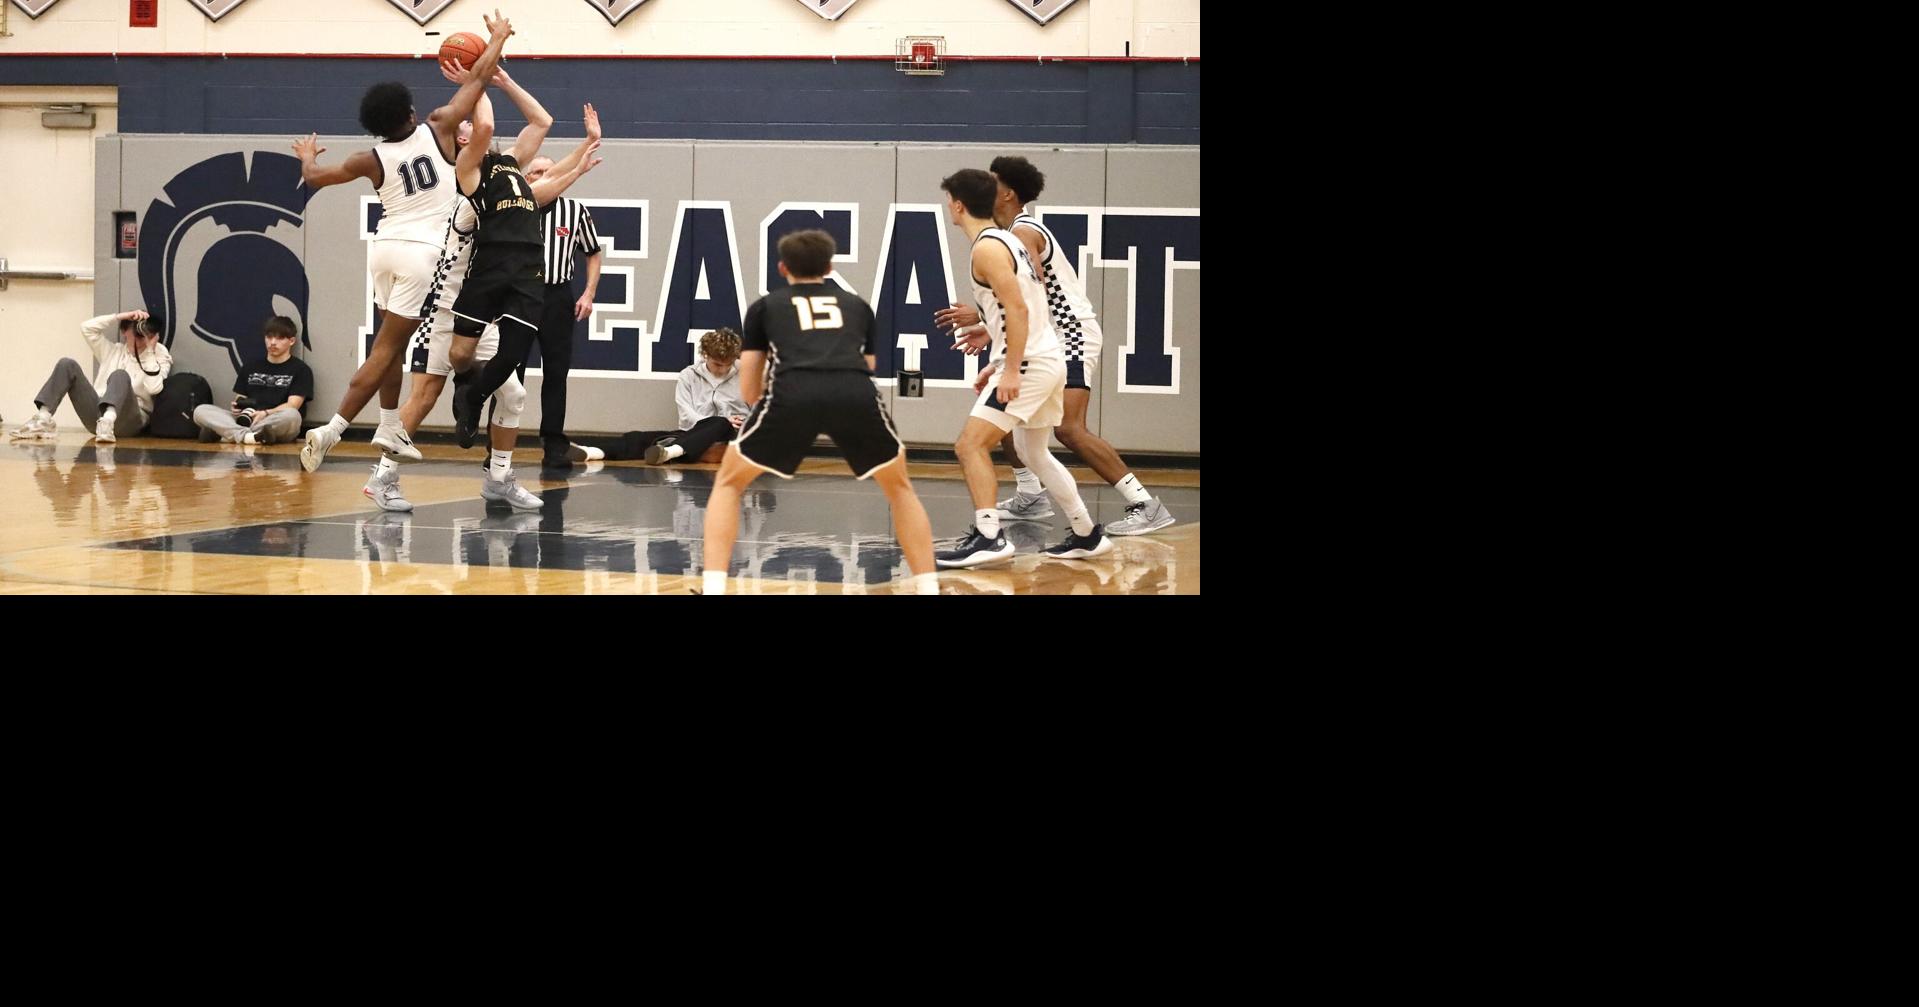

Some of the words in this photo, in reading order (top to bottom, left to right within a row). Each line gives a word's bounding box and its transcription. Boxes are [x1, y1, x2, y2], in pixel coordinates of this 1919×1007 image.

[397, 154, 439, 196] 10
[507, 174, 522, 196] 1
[791, 295, 844, 331] 15
